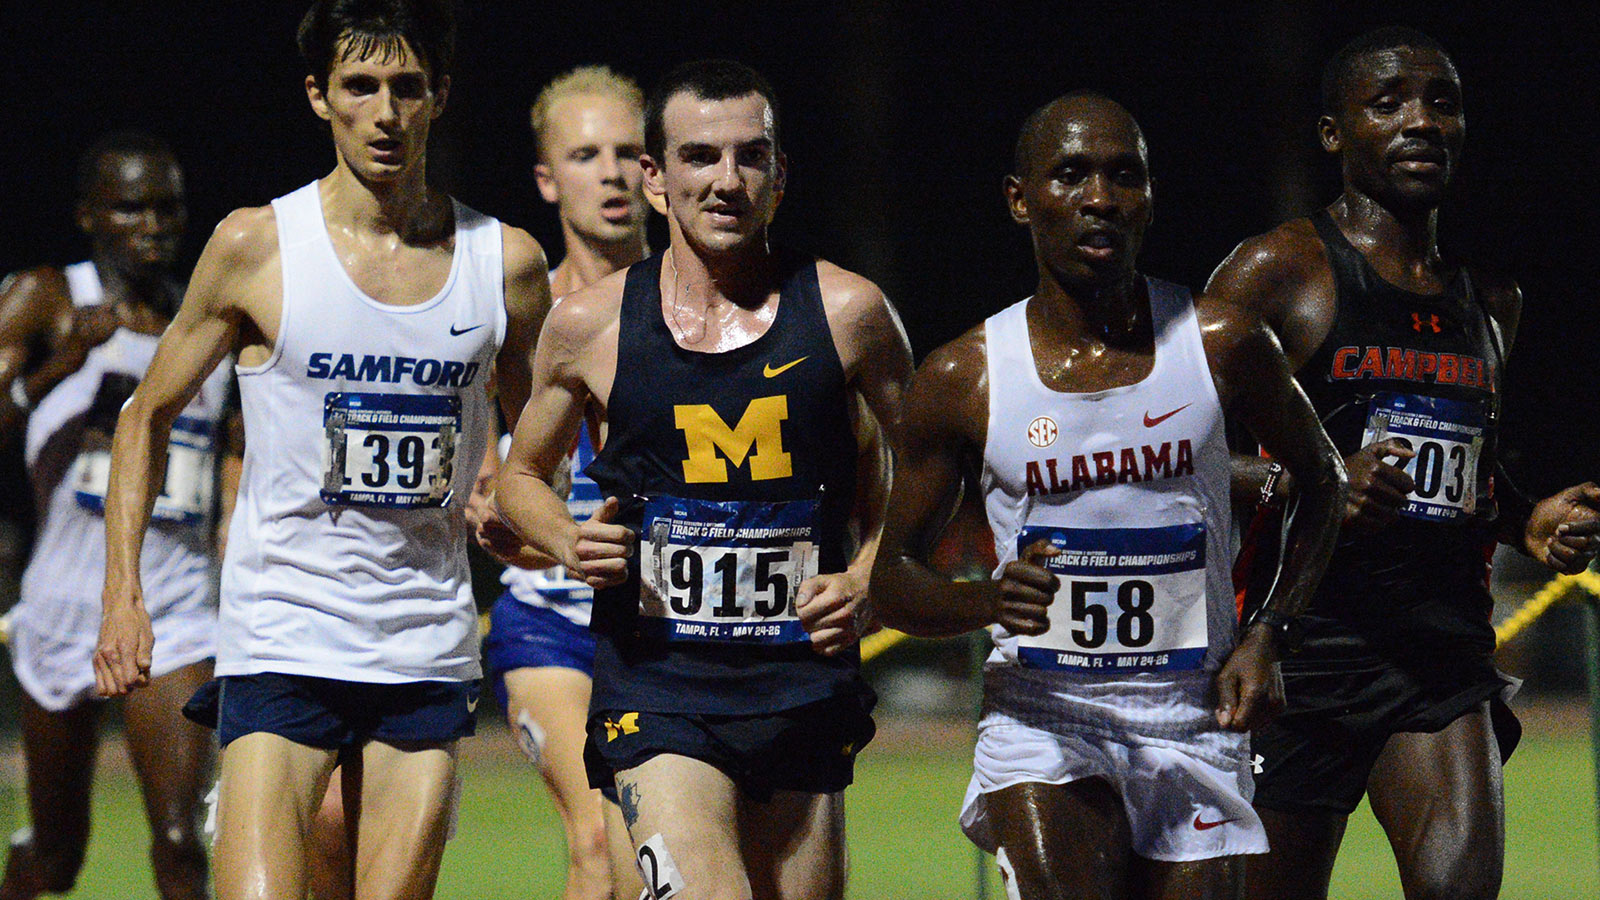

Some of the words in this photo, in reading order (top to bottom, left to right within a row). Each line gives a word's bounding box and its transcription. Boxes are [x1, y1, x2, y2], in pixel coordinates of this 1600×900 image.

[306, 352, 480, 388] SAMFORD
[347, 413, 372, 423] TRACK
[378, 414, 399, 424] FIELD
[1028, 417, 1058, 446] SEC
[1389, 414, 1413, 426] TRACK
[1419, 419, 1438, 429] FIELD
[673, 394, 793, 483] M
[1026, 439, 1194, 497] ALABAMA
[671, 524, 700, 536] TRACK
[708, 527, 735, 538] FIELD
[736, 527, 812, 539] CHAMPIONSHIPS
[1089, 555, 1117, 567] FIELD
[1118, 550, 1197, 567] CHAMPIONSHIPS
[670, 549, 790, 618] 915
[1071, 579, 1155, 649] 58
[675, 623, 708, 636] TAMPA,
[709, 626, 720, 637] FL
[732, 626, 753, 637] MAY
[755, 625, 781, 636] 24-26
[1057, 653, 1090, 667] TAMPA,
[1093, 656, 1104, 667] FL
[1116, 655, 1138, 667] MAY
[1140, 654, 1169, 666] 24-26
[639, 845, 672, 900] 2
